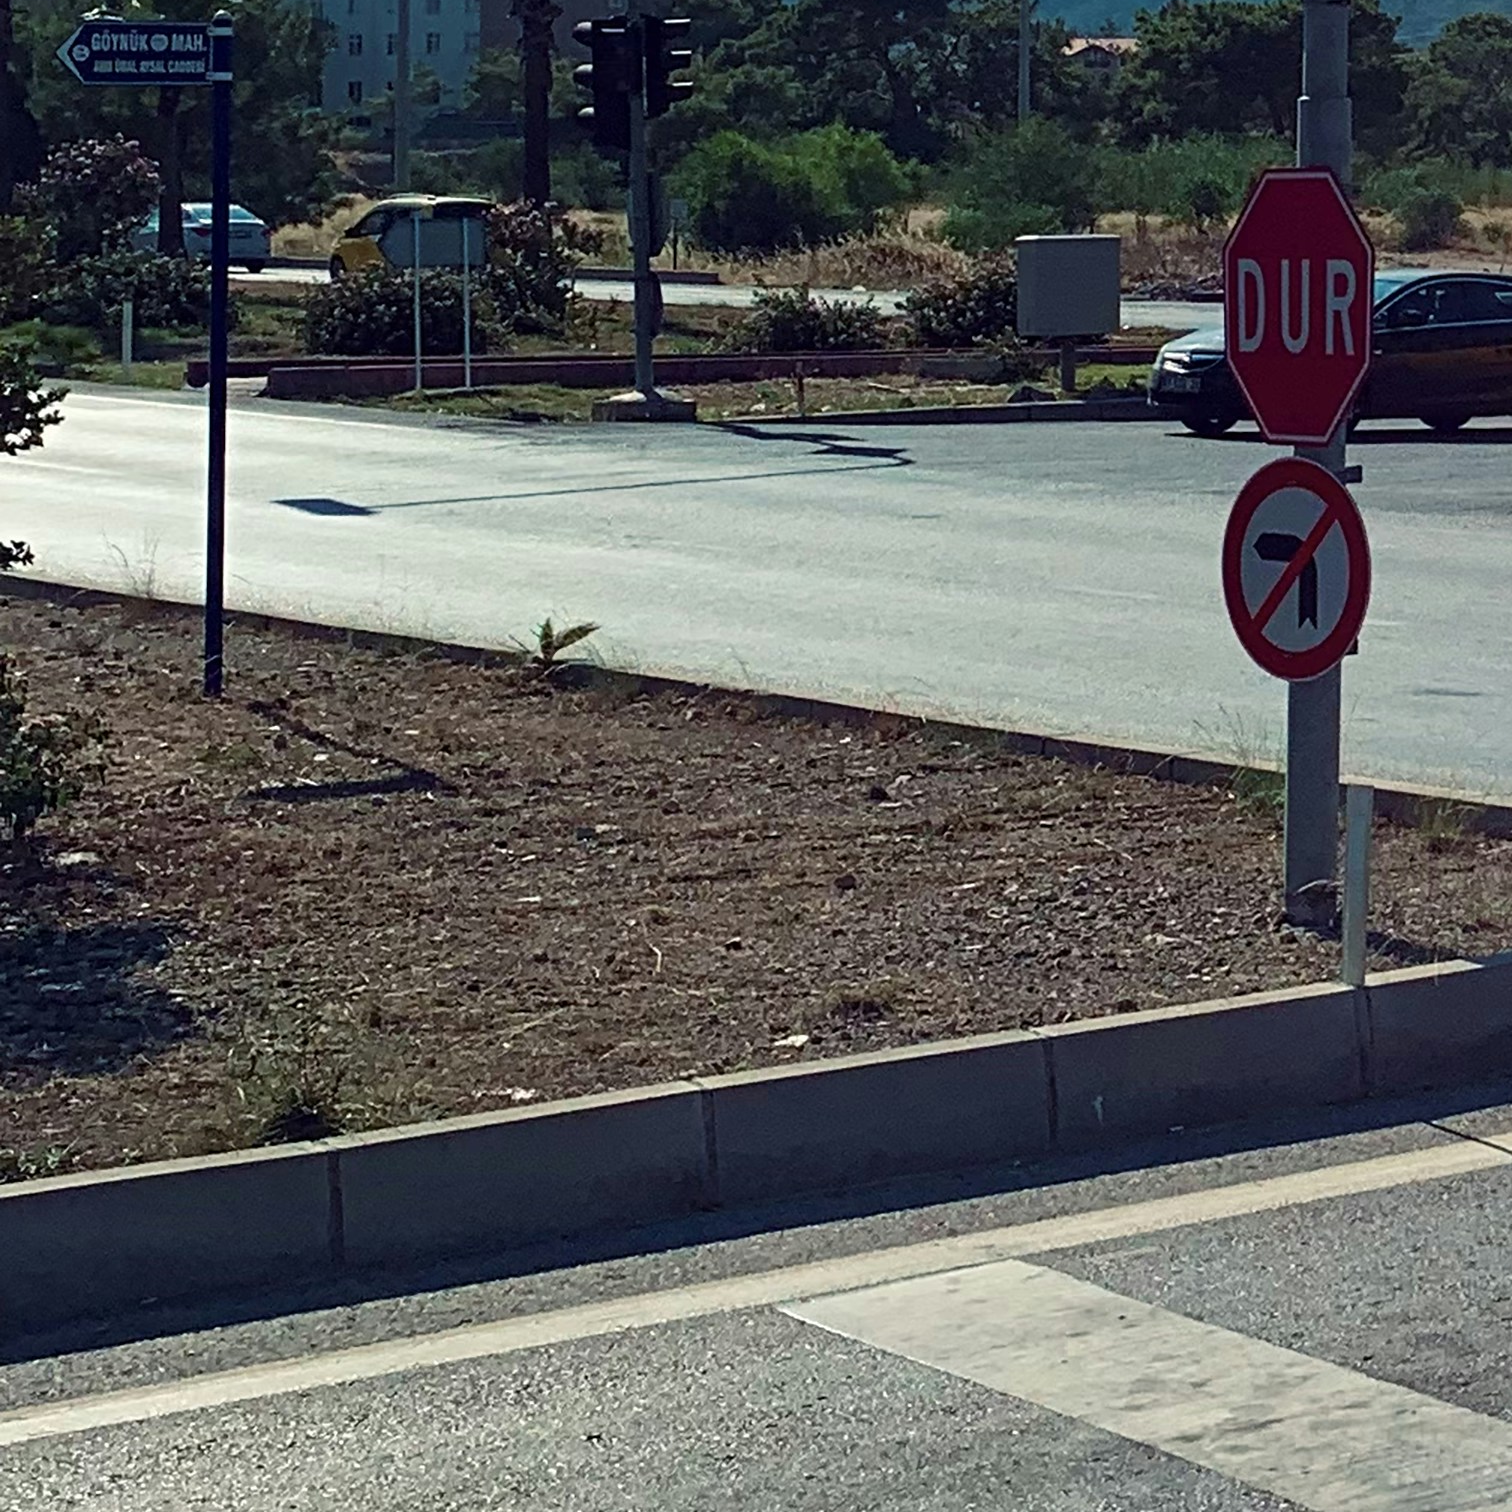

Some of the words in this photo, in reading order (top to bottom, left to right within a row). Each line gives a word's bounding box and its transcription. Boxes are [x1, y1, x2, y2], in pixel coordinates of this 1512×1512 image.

[91, 29, 149, 51] GÖYNÜK
[171, 33, 208, 52] MAH.
[1236, 257, 1357, 356] DUR
